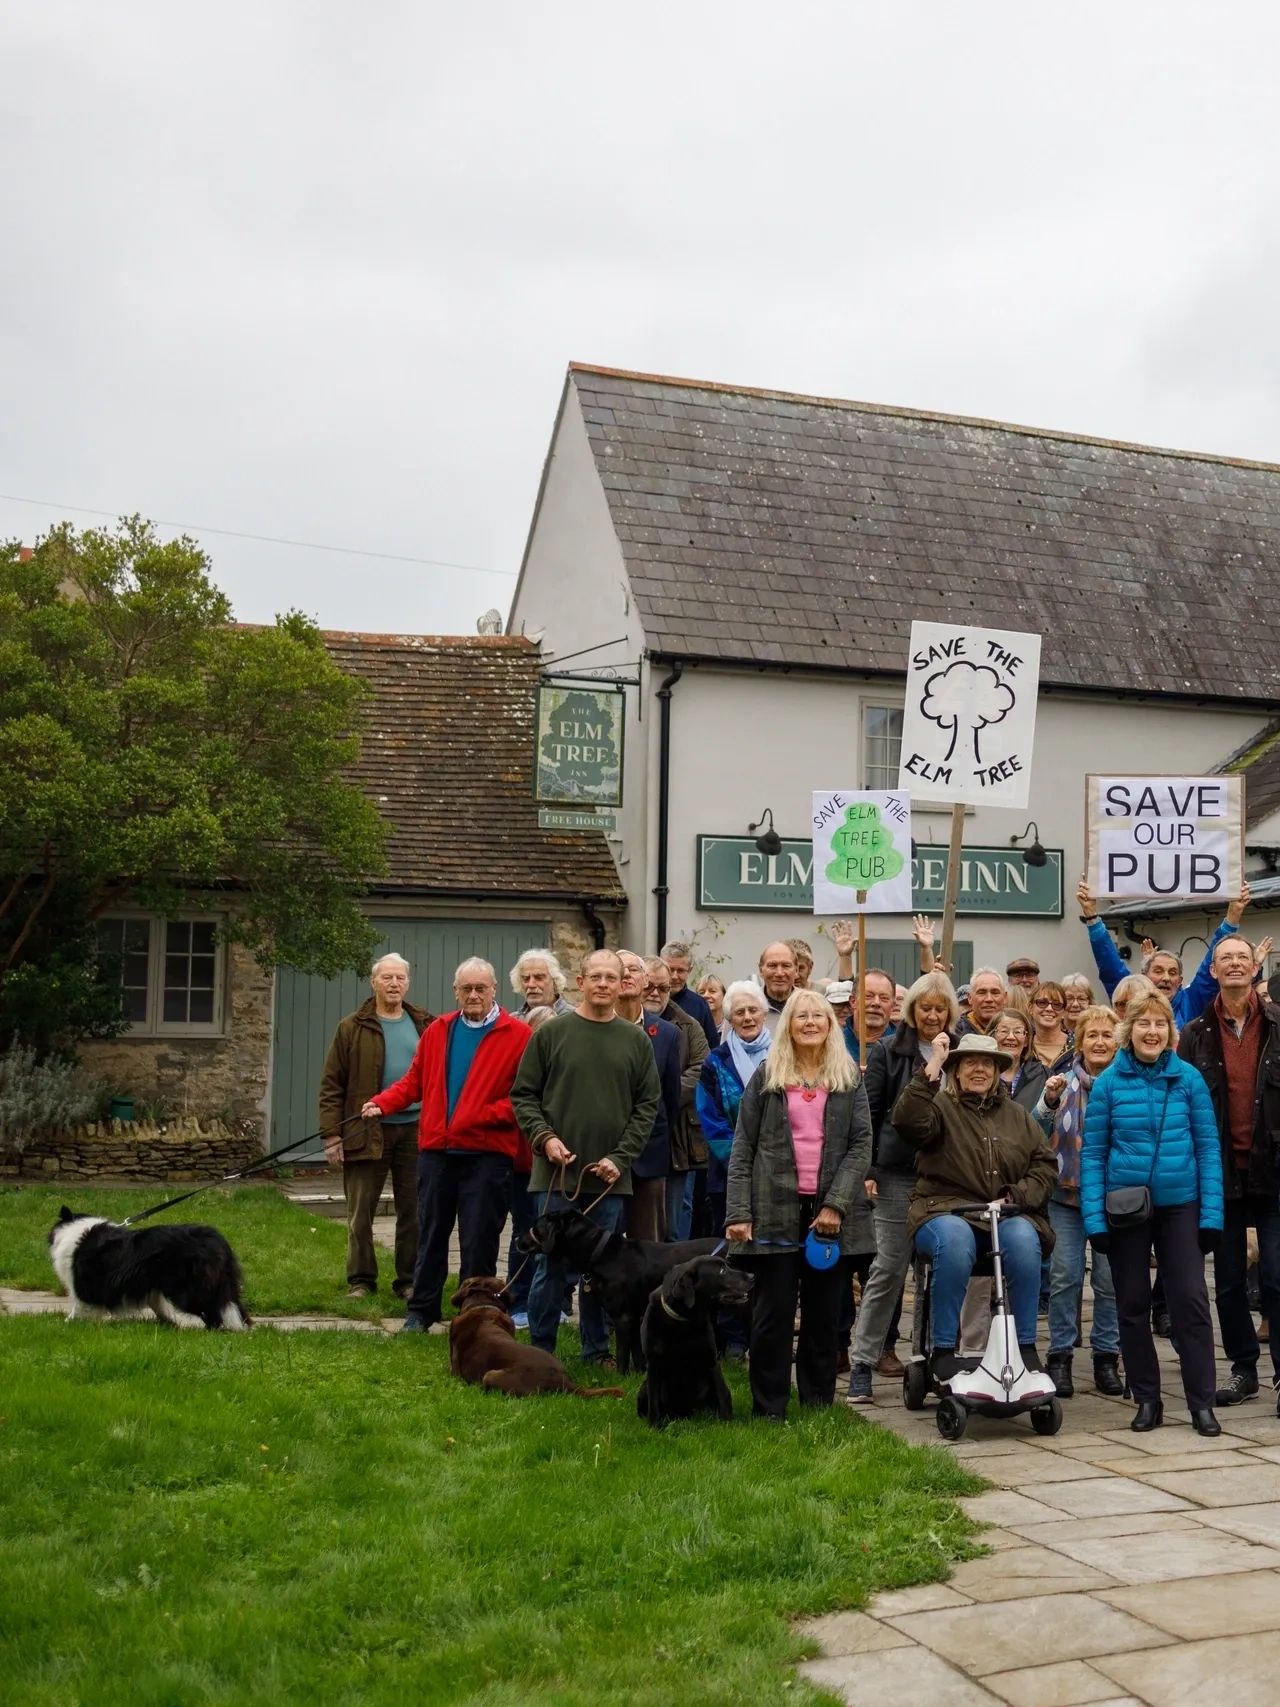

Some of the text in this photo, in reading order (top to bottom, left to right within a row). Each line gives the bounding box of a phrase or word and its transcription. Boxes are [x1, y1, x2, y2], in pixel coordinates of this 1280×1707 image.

[912, 637, 1024, 677] SAVE THE
[571, 707, 591, 716] THE
[559, 720, 603, 741] ELM
[551, 743, 609, 764] TREE
[570, 769, 588, 777] INN
[904, 753, 1023, 787] ELM TREE
[813, 793, 909, 829] SAVE THE
[1105, 785, 1221, 817] SAVE
[544, 815, 612, 827] FREE HOUSE
[849, 807, 877, 820] ELM
[840, 830, 880, 846] TREE
[1133, 822, 1195, 845] OUR
[739, 852, 814, 886] ELM
[961, 860, 1029, 894] INN
[846, 856, 885, 879] PUB
[1108, 853, 1222, 894] PUB
